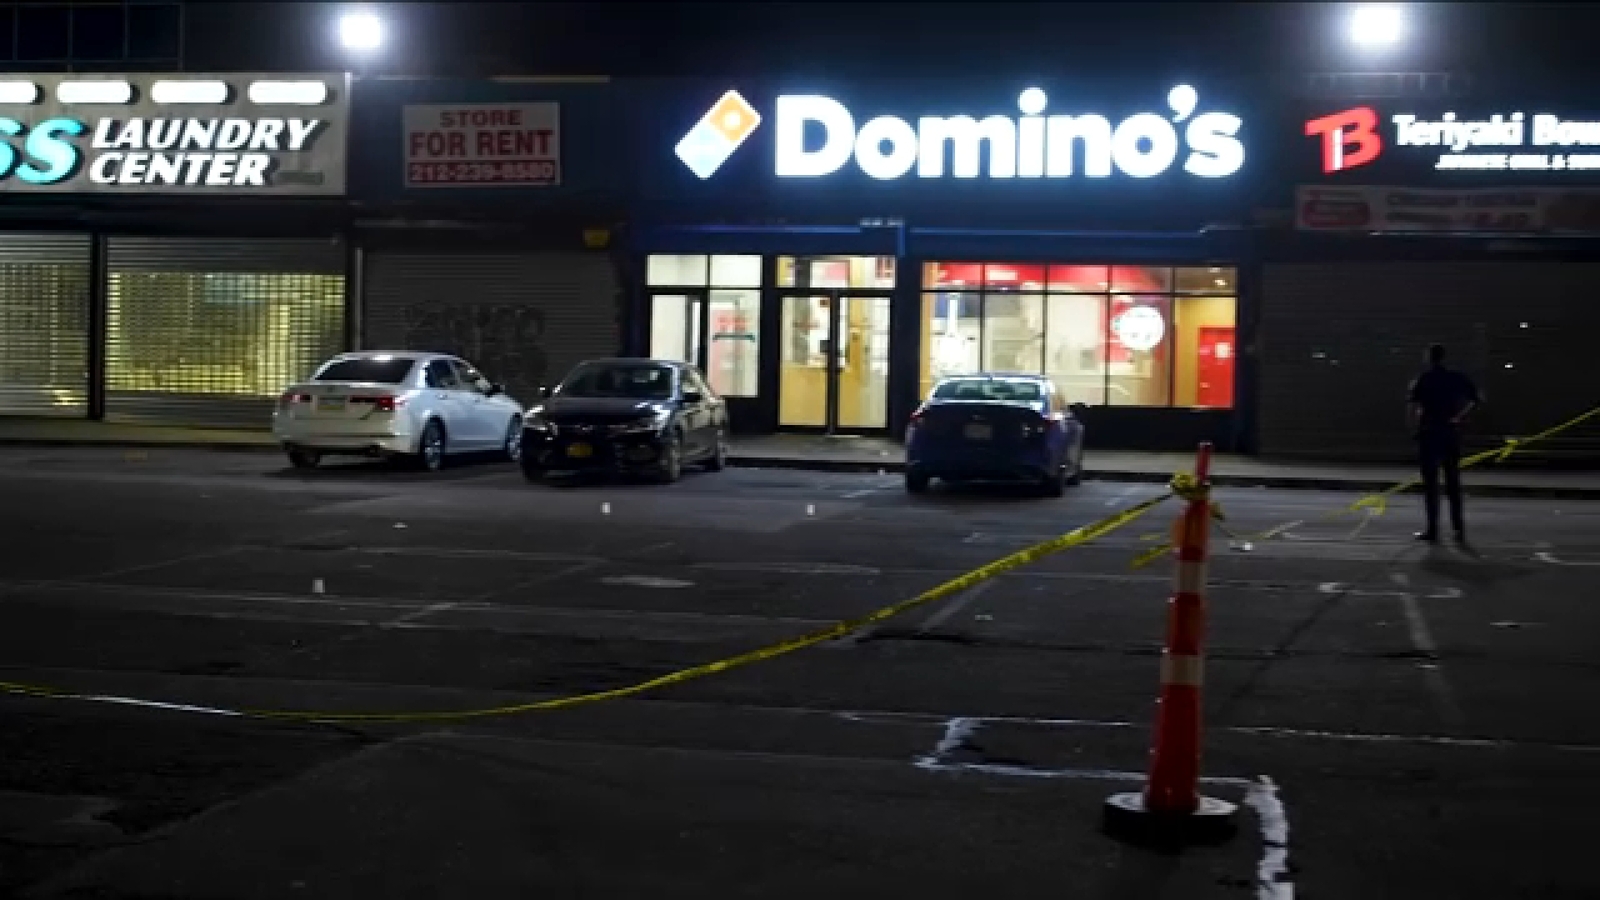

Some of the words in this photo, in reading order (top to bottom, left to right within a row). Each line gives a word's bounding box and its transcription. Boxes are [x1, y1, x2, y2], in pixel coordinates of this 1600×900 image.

[91, 118, 320, 149] LAUNDRY
[440, 110, 522, 127] STORE
[774, 84, 1246, 179] Domino's
[1391, 111, 1524, 151] Teriyaki
[409, 131, 466, 157] FOR
[476, 129, 555, 156] RENT
[89, 152, 271, 185] CENTER
